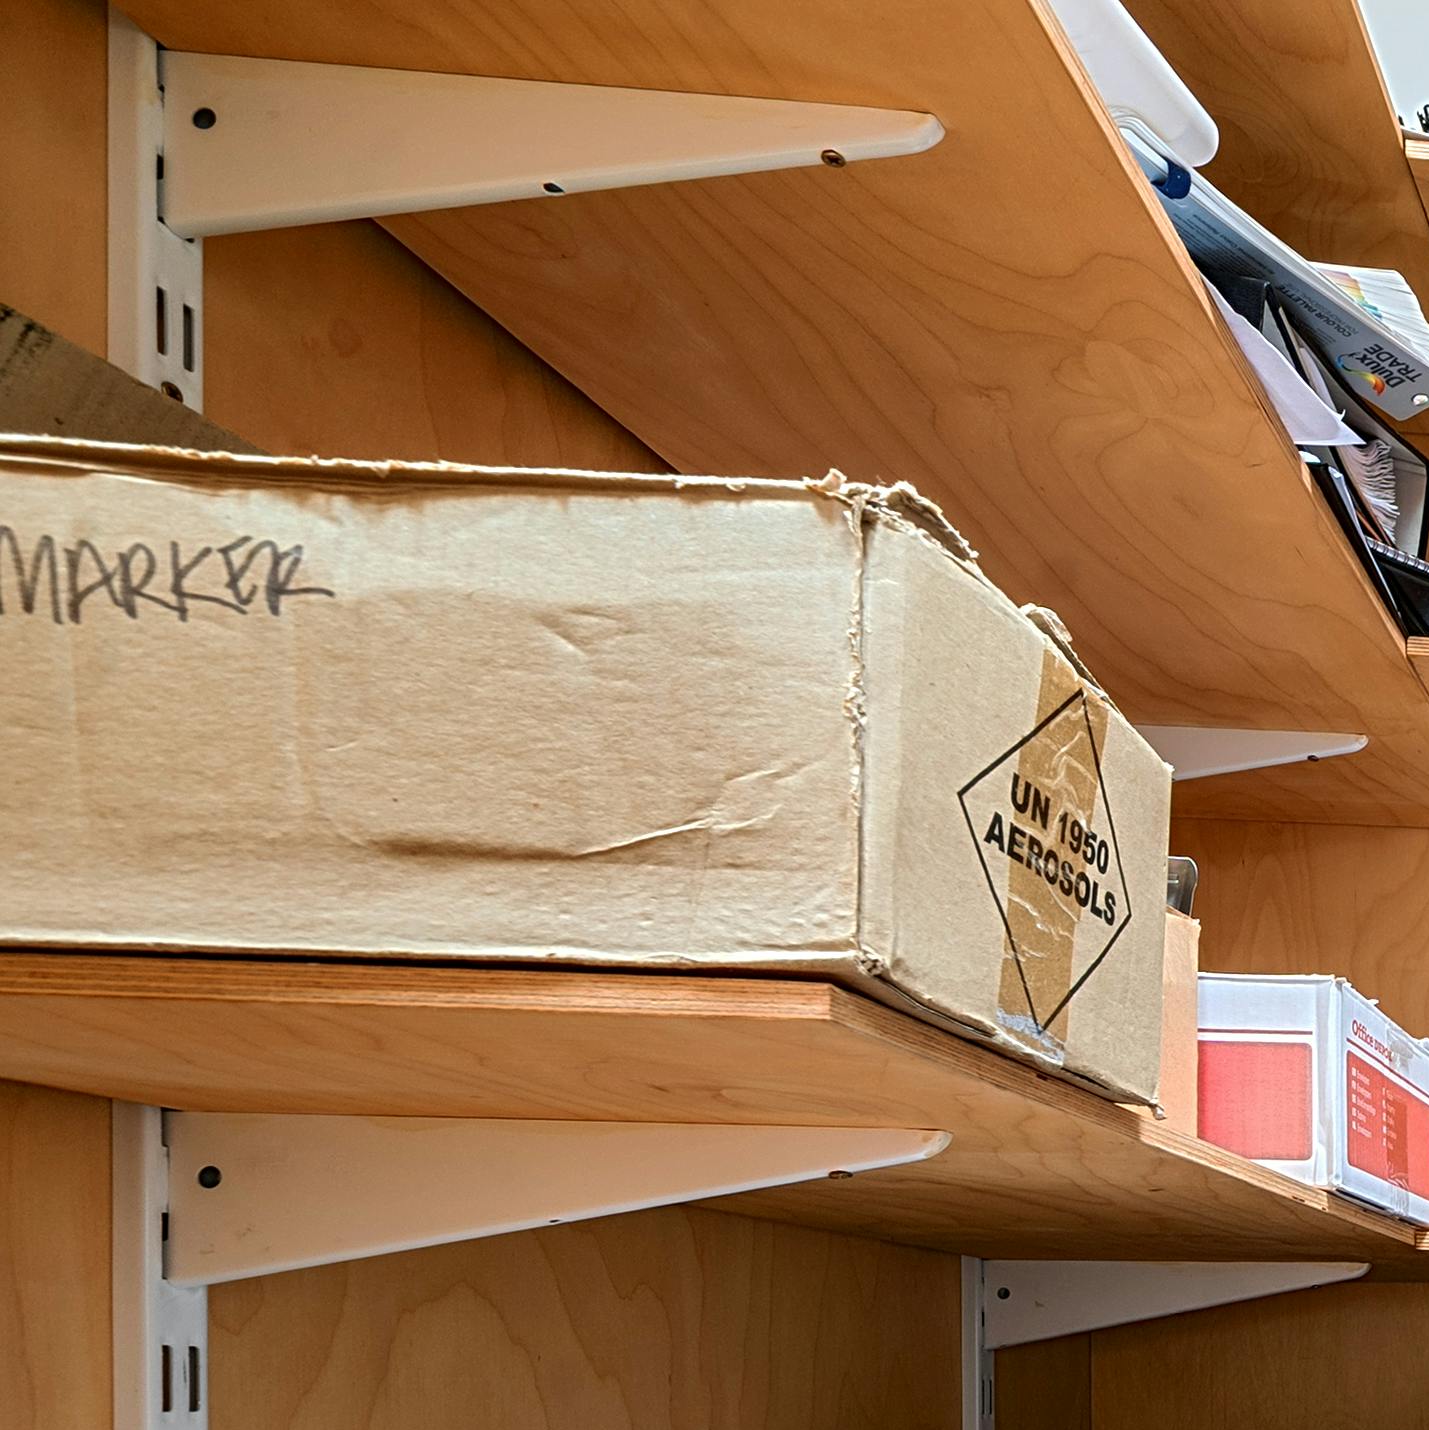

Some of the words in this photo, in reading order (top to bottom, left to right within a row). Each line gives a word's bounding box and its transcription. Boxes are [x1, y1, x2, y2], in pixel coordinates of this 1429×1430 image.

[1355, 354, 1406, 388] Dulux
[1363, 343, 1423, 384] TRADE
[1010, 772, 1052, 831] UN
[983, 810, 1117, 927] AEROSOLS
[1058, 810, 1110, 876] 1950
